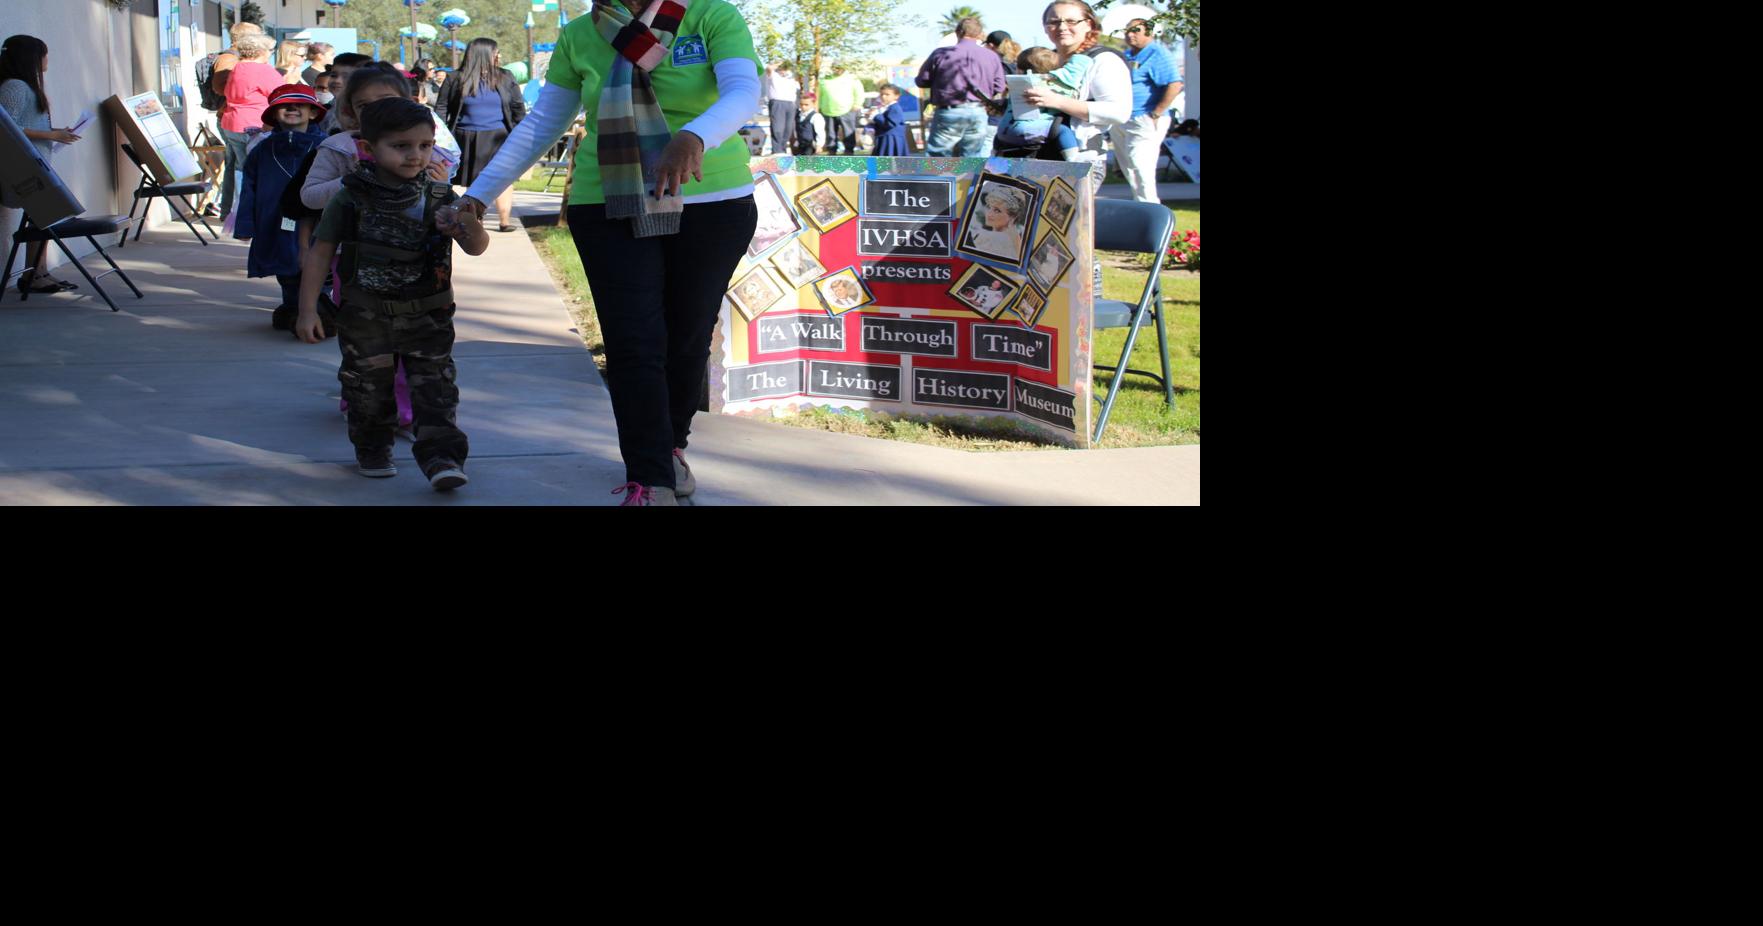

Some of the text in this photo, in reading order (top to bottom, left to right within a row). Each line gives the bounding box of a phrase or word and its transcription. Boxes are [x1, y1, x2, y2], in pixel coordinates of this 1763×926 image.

[883, 188, 931, 208] The
[861, 228, 948, 248] IVHSA
[861, 265, 951, 280] presents
[790, 320, 842, 340] Walk
[863, 324, 955, 348] Through
[746, 369, 1075, 419] The Living History Museum
